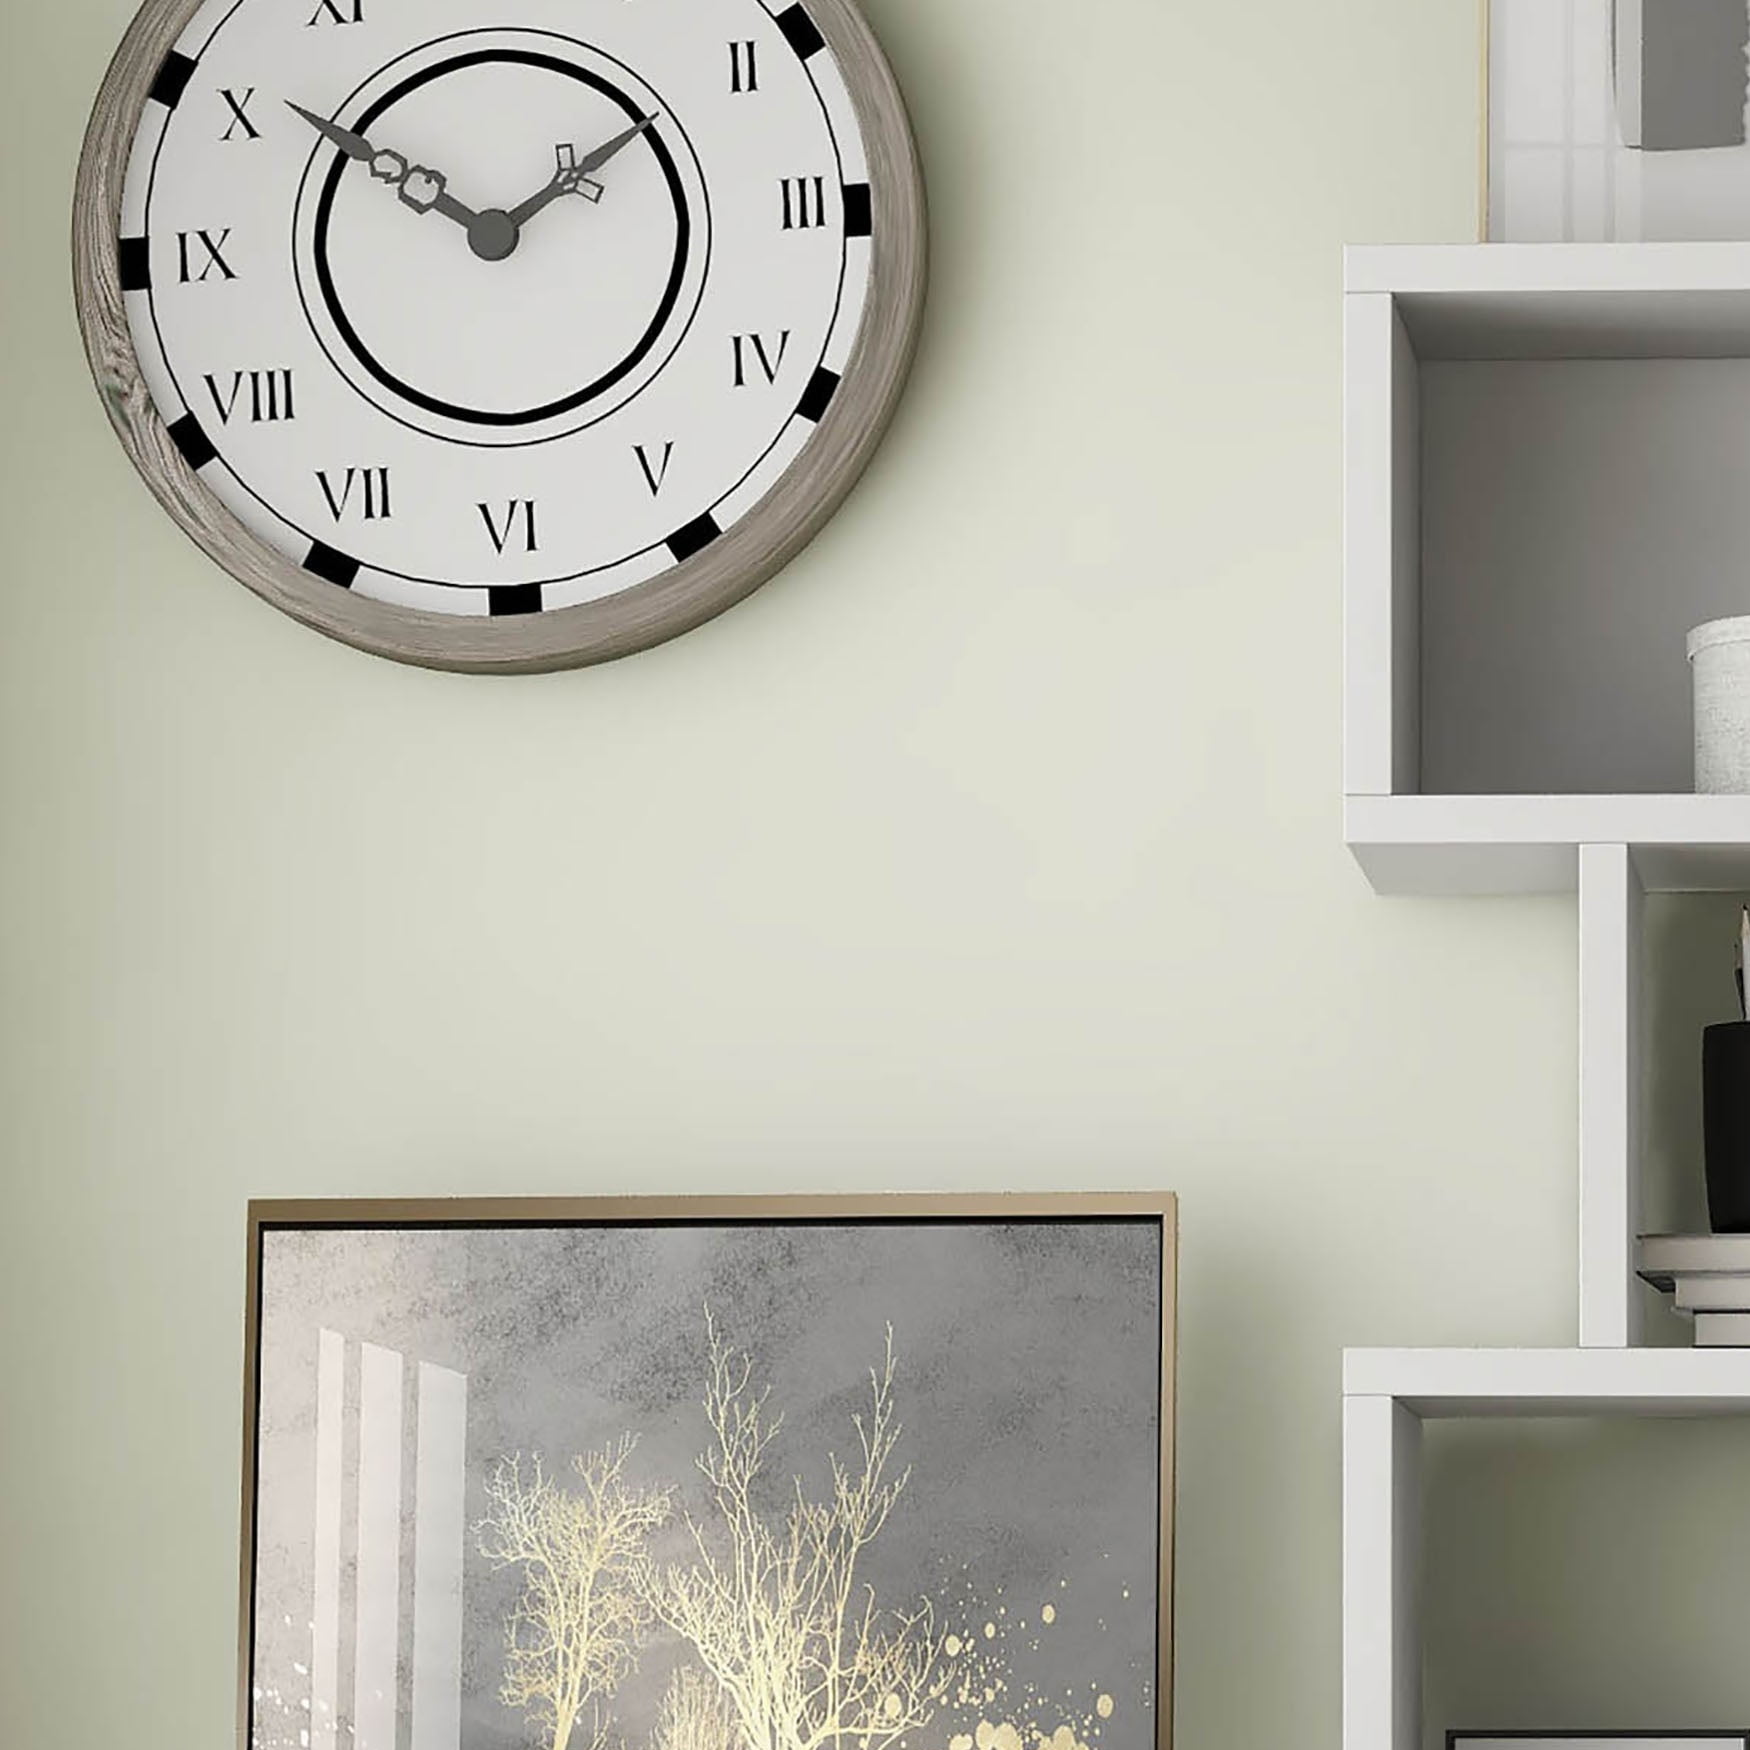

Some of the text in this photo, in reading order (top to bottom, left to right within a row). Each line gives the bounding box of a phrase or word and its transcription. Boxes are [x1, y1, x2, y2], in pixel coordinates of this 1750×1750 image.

[729, 41, 758, 92] II
[217, 88, 261, 141] X
[780, 177, 825, 229] III
[175, 230, 239, 282] IX
[731, 331, 789, 386] IV
[203, 369, 294, 423] VIII
[316, 468, 391, 520] VII
[632, 441, 674, 495] V
[478, 499, 536, 552] VI
